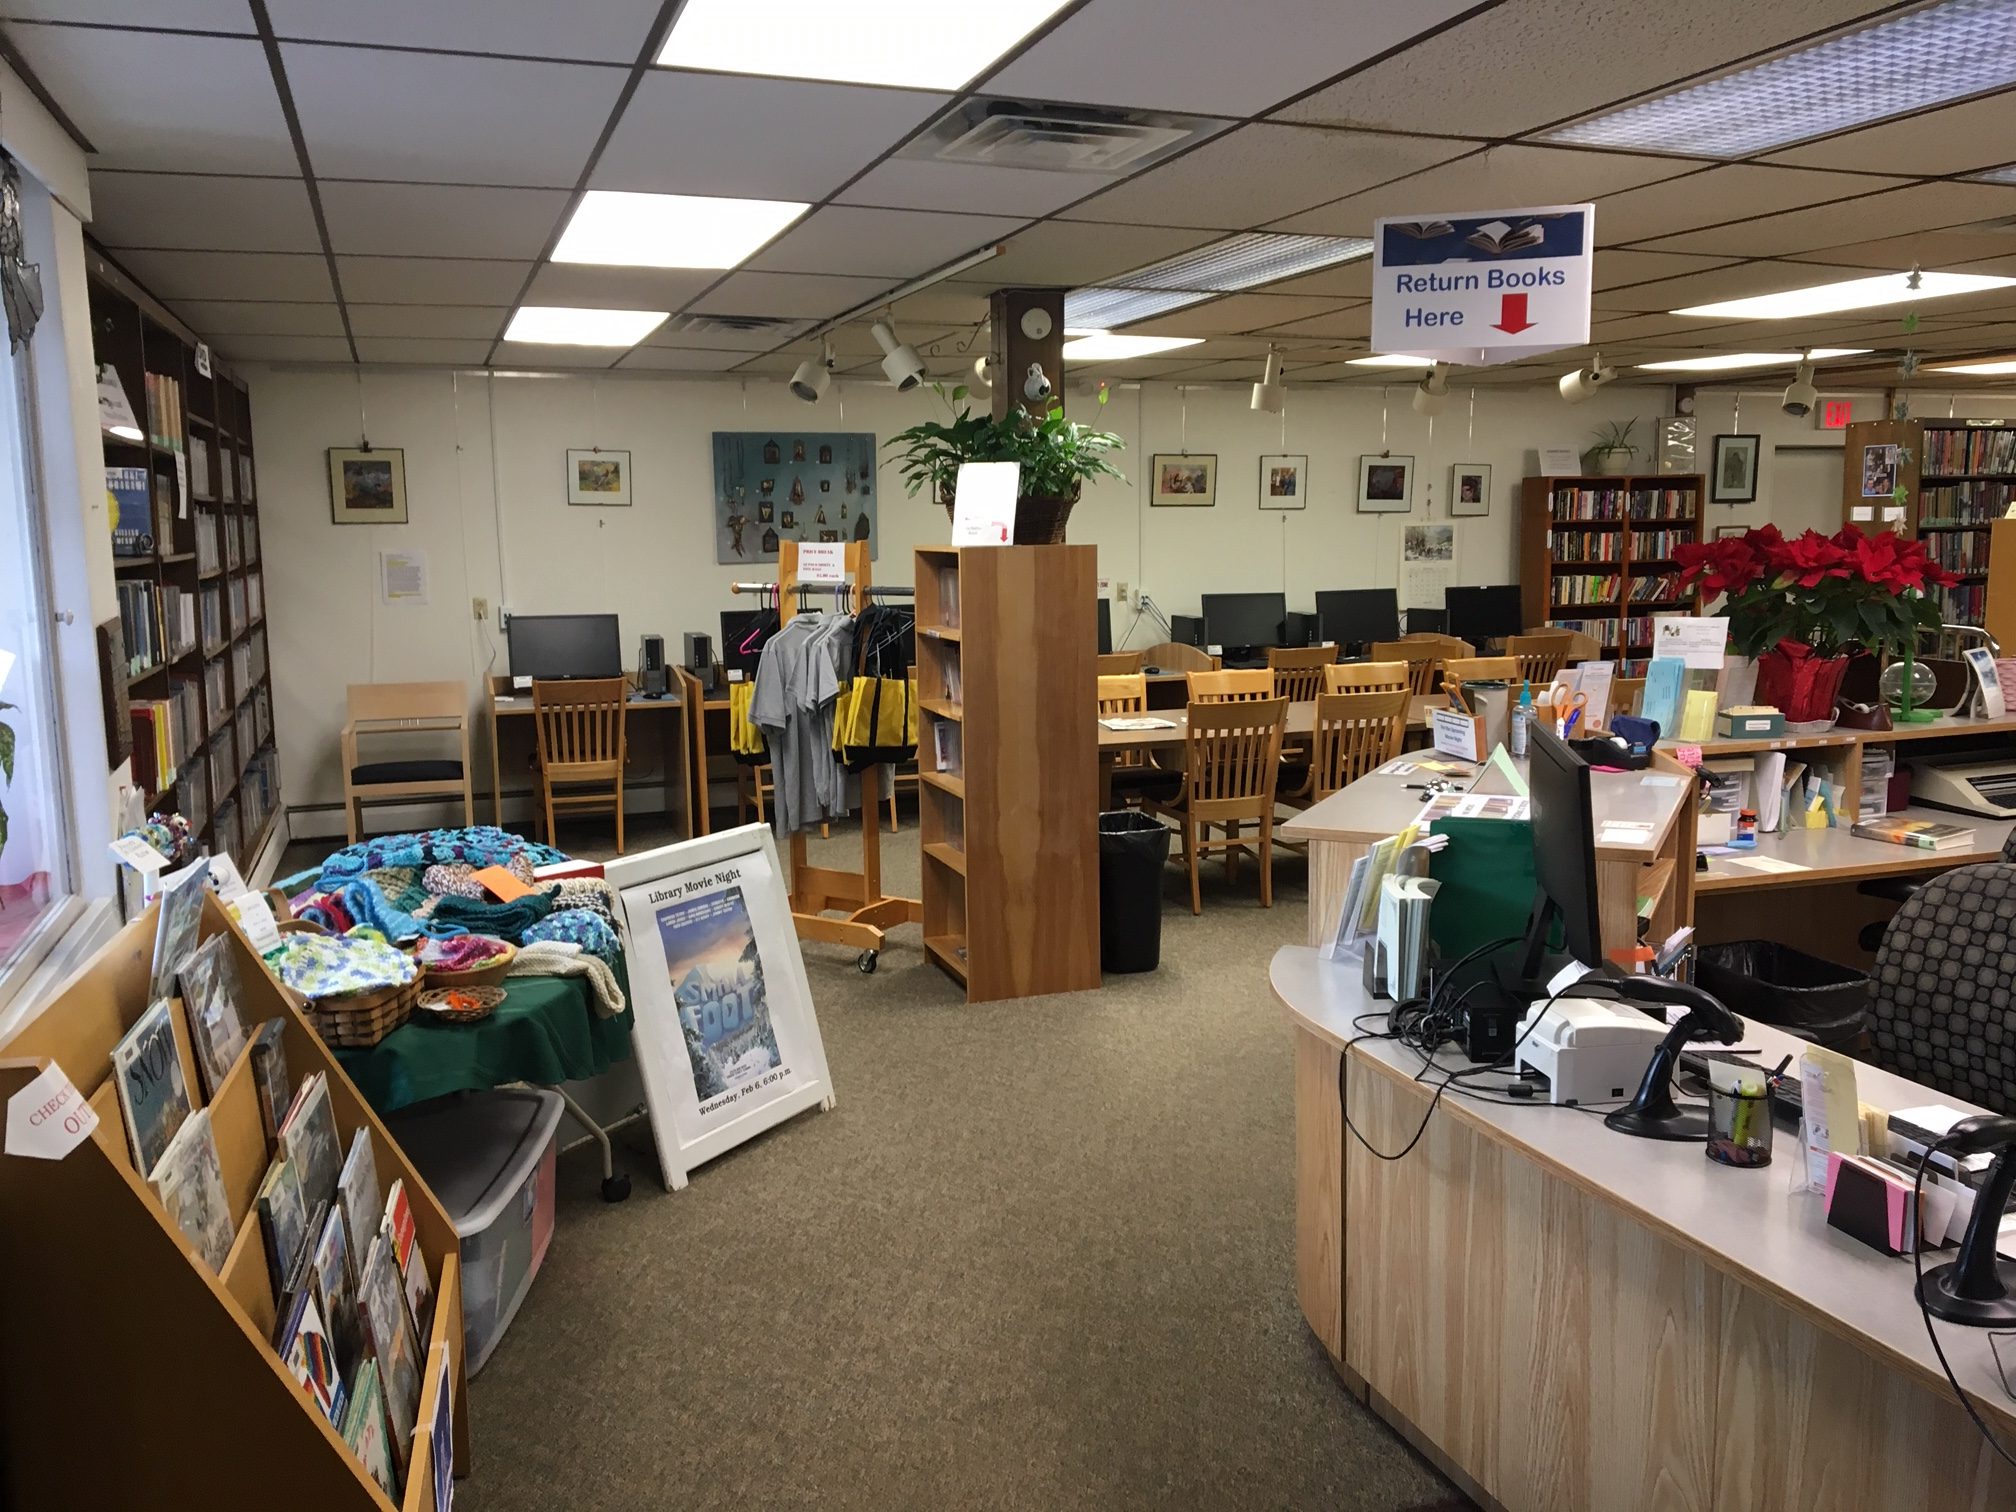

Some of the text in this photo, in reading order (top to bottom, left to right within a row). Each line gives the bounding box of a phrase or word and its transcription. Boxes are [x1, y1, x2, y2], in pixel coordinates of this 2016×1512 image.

[1396, 266, 1565, 294] Return Books
[1404, 307, 1464, 328] Here
[648, 868, 742, 904] Library Movie Night
[698, 1092, 740, 1116] Wednesday,
[741, 1084, 754, 1097] Feb
[763, 1072, 778, 1086] 6:00
[64, 1103, 91, 1134] OUT
